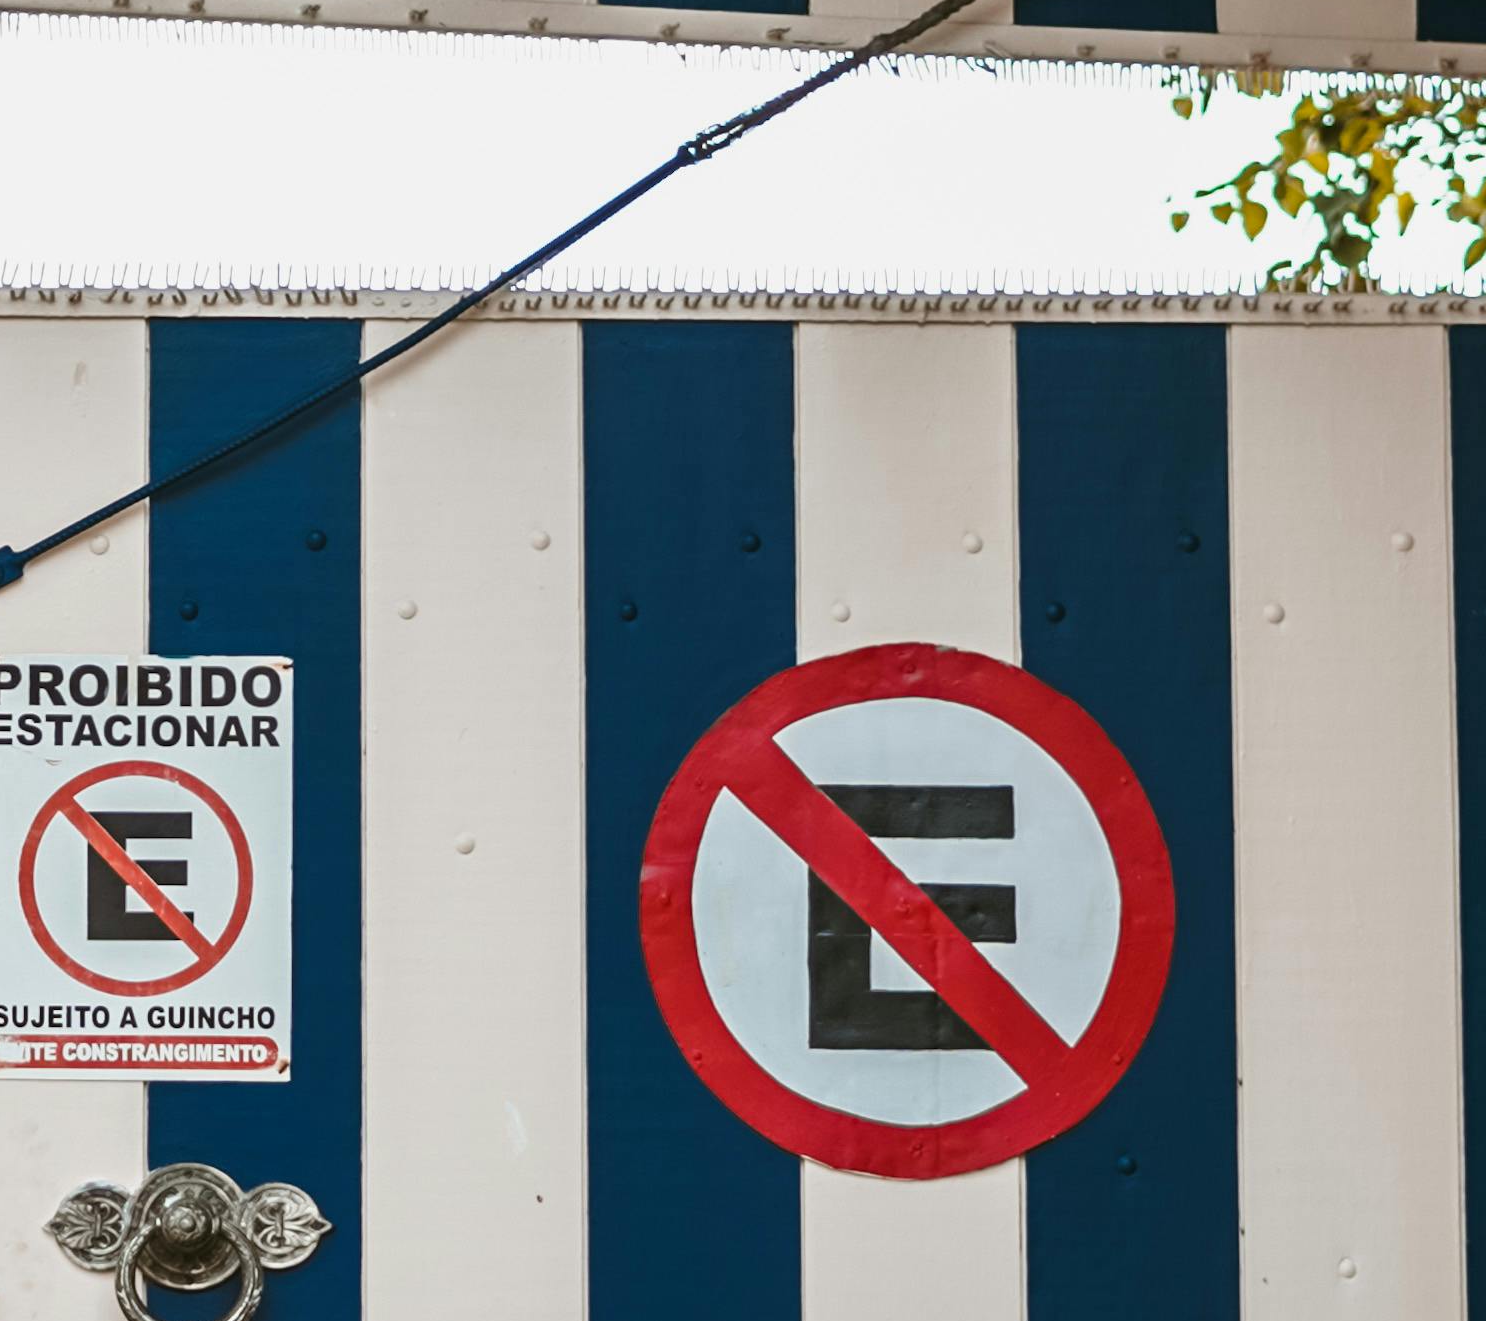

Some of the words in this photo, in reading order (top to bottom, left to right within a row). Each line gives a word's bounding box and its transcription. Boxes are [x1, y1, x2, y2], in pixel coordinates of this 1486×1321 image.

[87, 811, 194, 940] E
[807, 784, 1017, 1050] E
[62, 1042, 267, 1063] CONSTRANGIMENTO
[119, 1005, 138, 1028] A
[147, 1006, 275, 1029] GUINCHO
